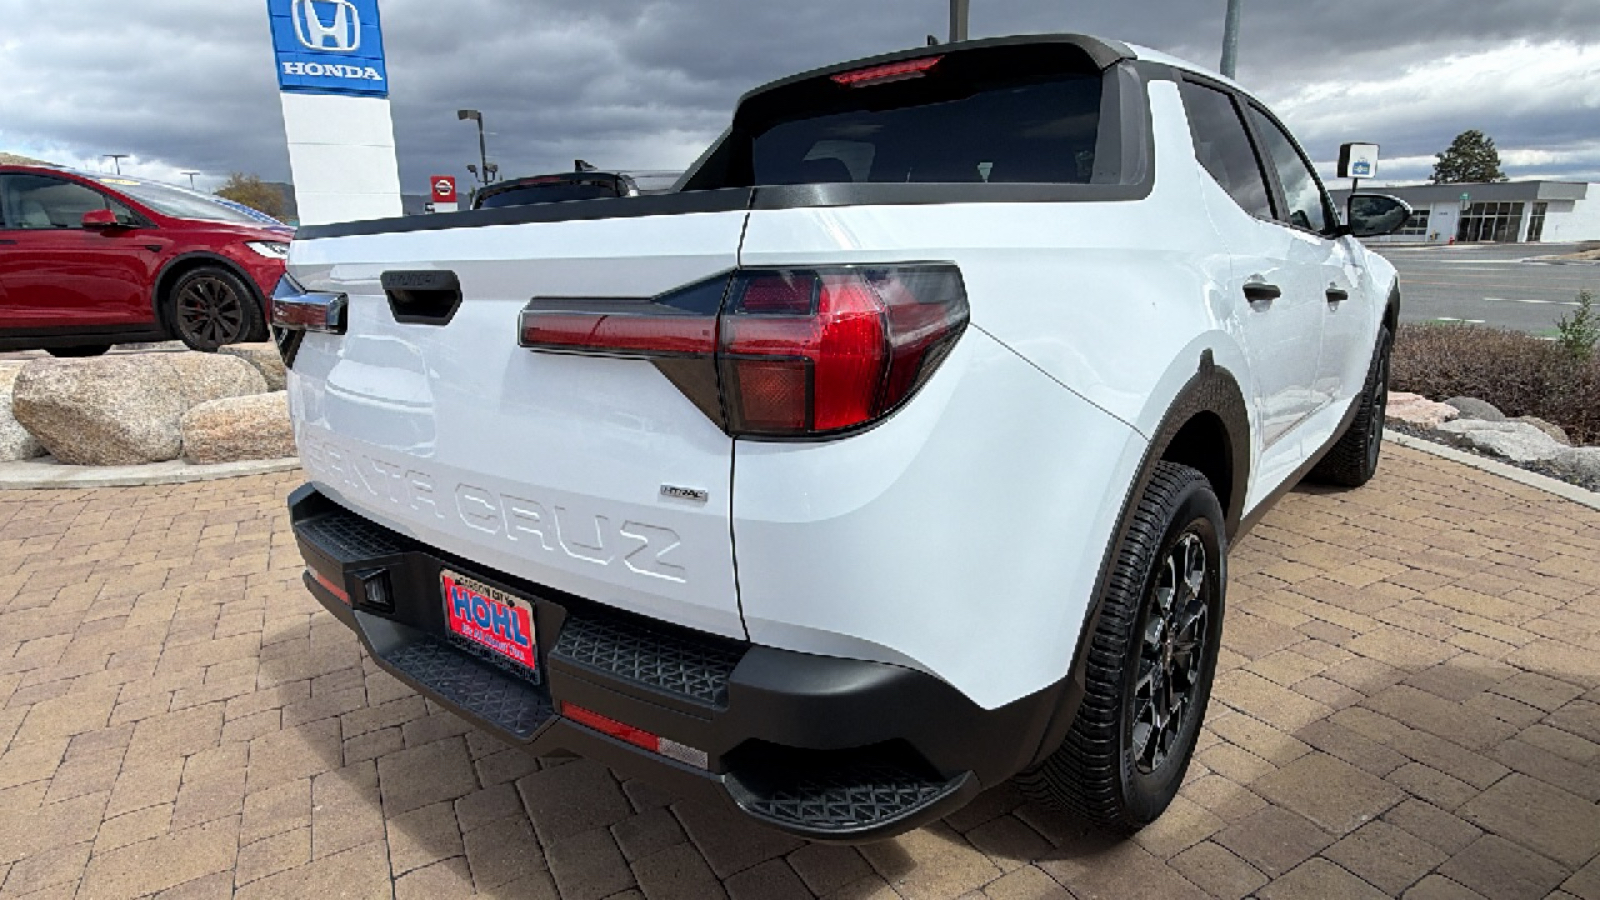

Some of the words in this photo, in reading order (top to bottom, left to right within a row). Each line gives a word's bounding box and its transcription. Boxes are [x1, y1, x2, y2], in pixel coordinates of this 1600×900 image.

[282, 62, 383, 80] HONDA
[306, 435, 446, 519] SANTA
[455, 482, 687, 584] CRUZ
[451, 586, 528, 647] HOHL
